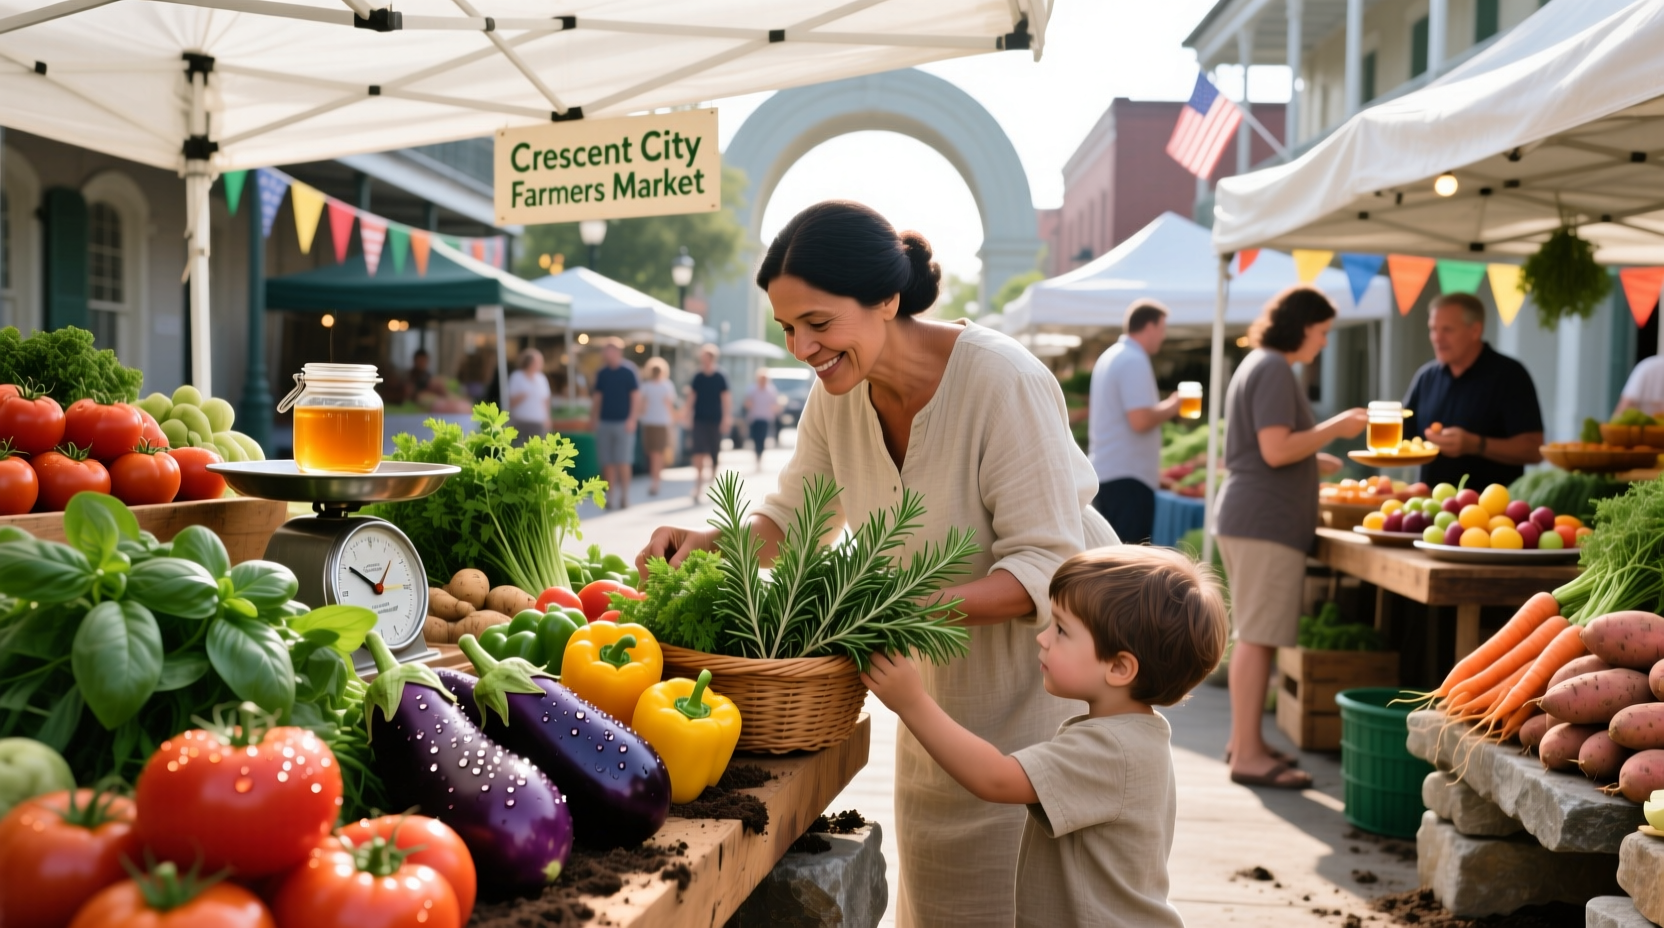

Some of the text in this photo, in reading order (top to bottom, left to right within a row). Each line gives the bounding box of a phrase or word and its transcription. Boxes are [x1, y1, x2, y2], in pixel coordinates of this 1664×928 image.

[510, 129, 702, 173] Crescent City
[512, 168, 705, 208] Farmers Market
